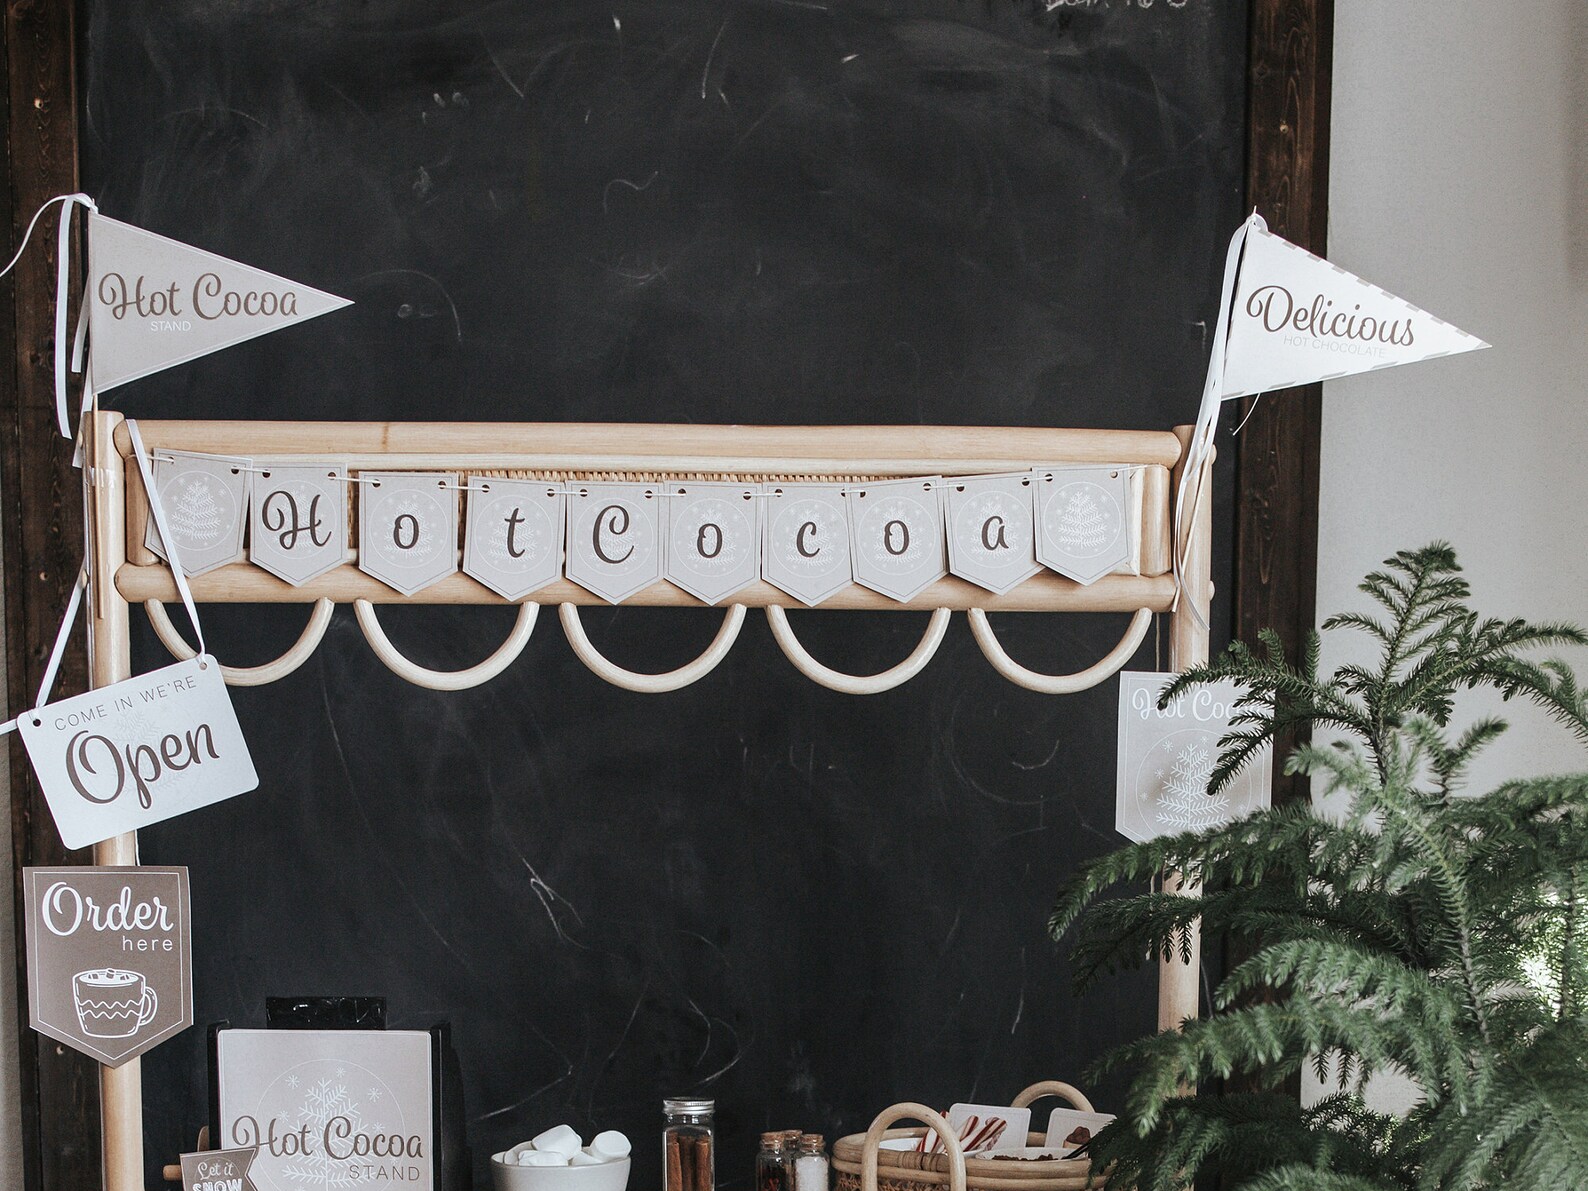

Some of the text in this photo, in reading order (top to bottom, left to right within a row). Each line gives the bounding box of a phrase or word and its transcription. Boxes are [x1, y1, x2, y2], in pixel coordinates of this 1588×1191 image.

[99, 272, 299, 321] Hot Cocoa
[1245, 285, 1415, 347] Delicious
[150, 320, 192, 332] STAND
[1283, 335, 1387, 359] HOT CHOCOLATE
[54, 675, 197, 731] COME IN WE'RE
[1132, 687, 1186, 720] Hot
[66, 723, 220, 810] Open
[42, 881, 174, 936] Order
[122, 935, 173, 951] here
[232, 1115, 424, 1160] Hot Cocoa
[197, 1161, 234, 1181] Let it
[349, 1164, 421, 1182] STAND
